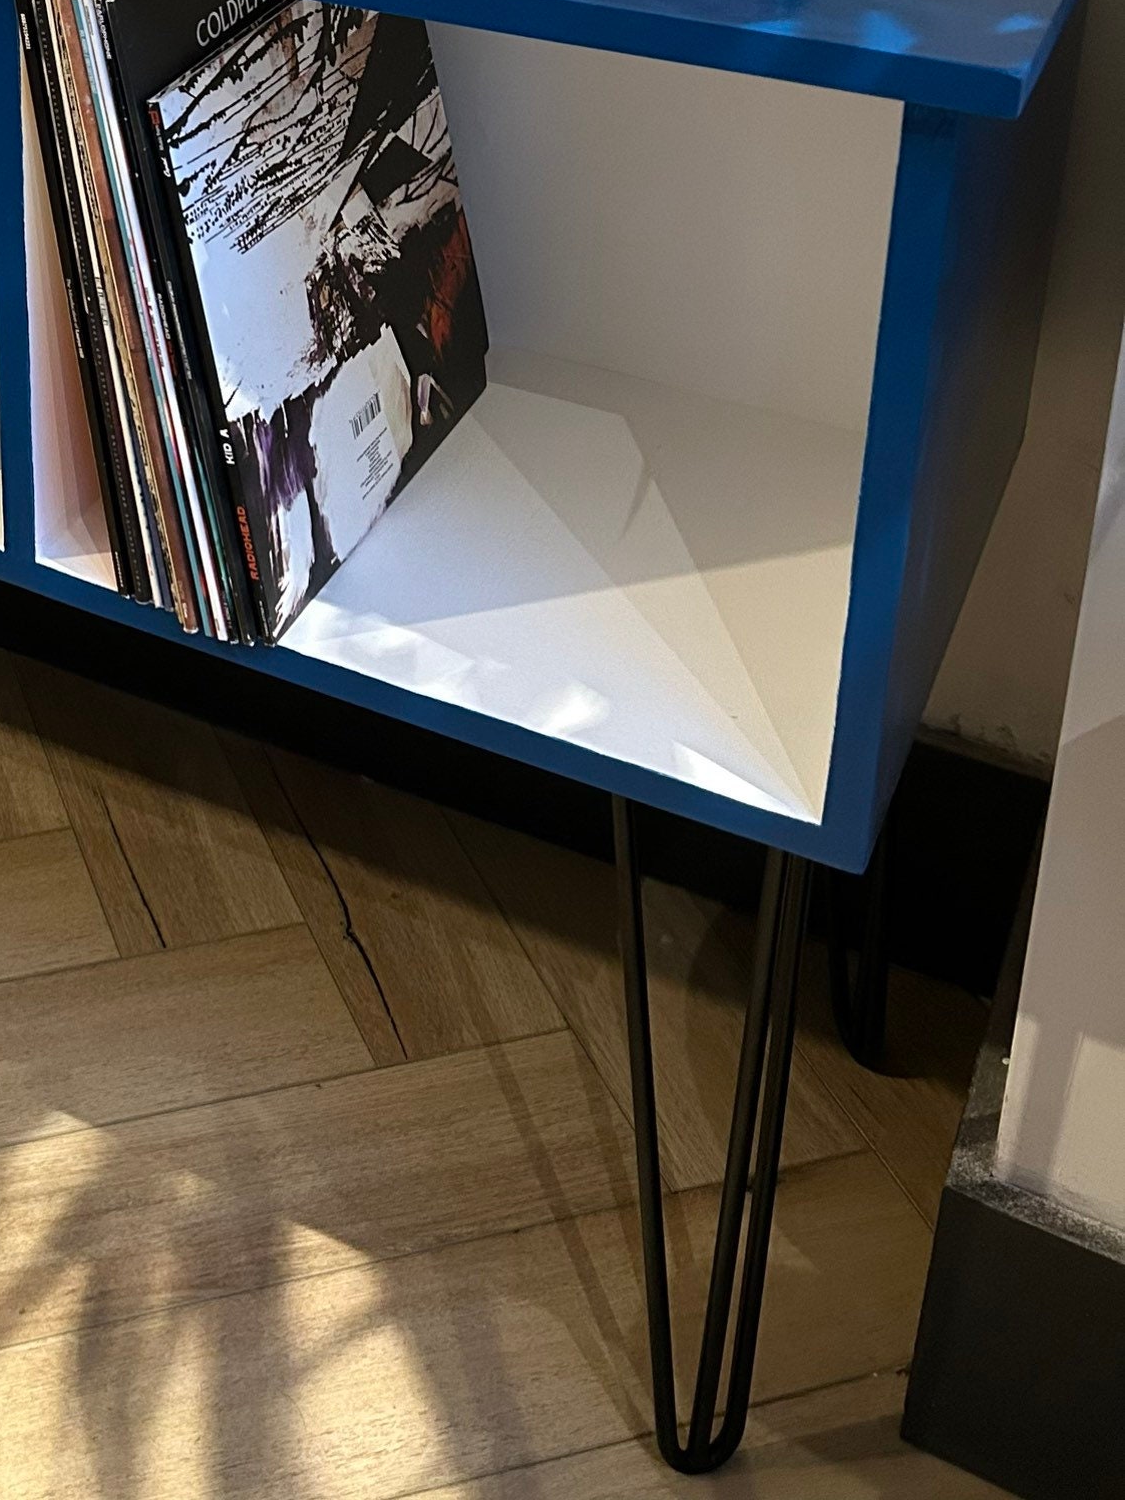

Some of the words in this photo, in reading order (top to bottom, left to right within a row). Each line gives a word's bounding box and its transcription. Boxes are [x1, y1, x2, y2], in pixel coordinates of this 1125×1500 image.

[157, 292, 171, 340] RADIOHEAD
[220, 428, 229, 440] A
[225, 443, 236, 466] KID
[238, 505, 260, 581] RADIOHEAD
